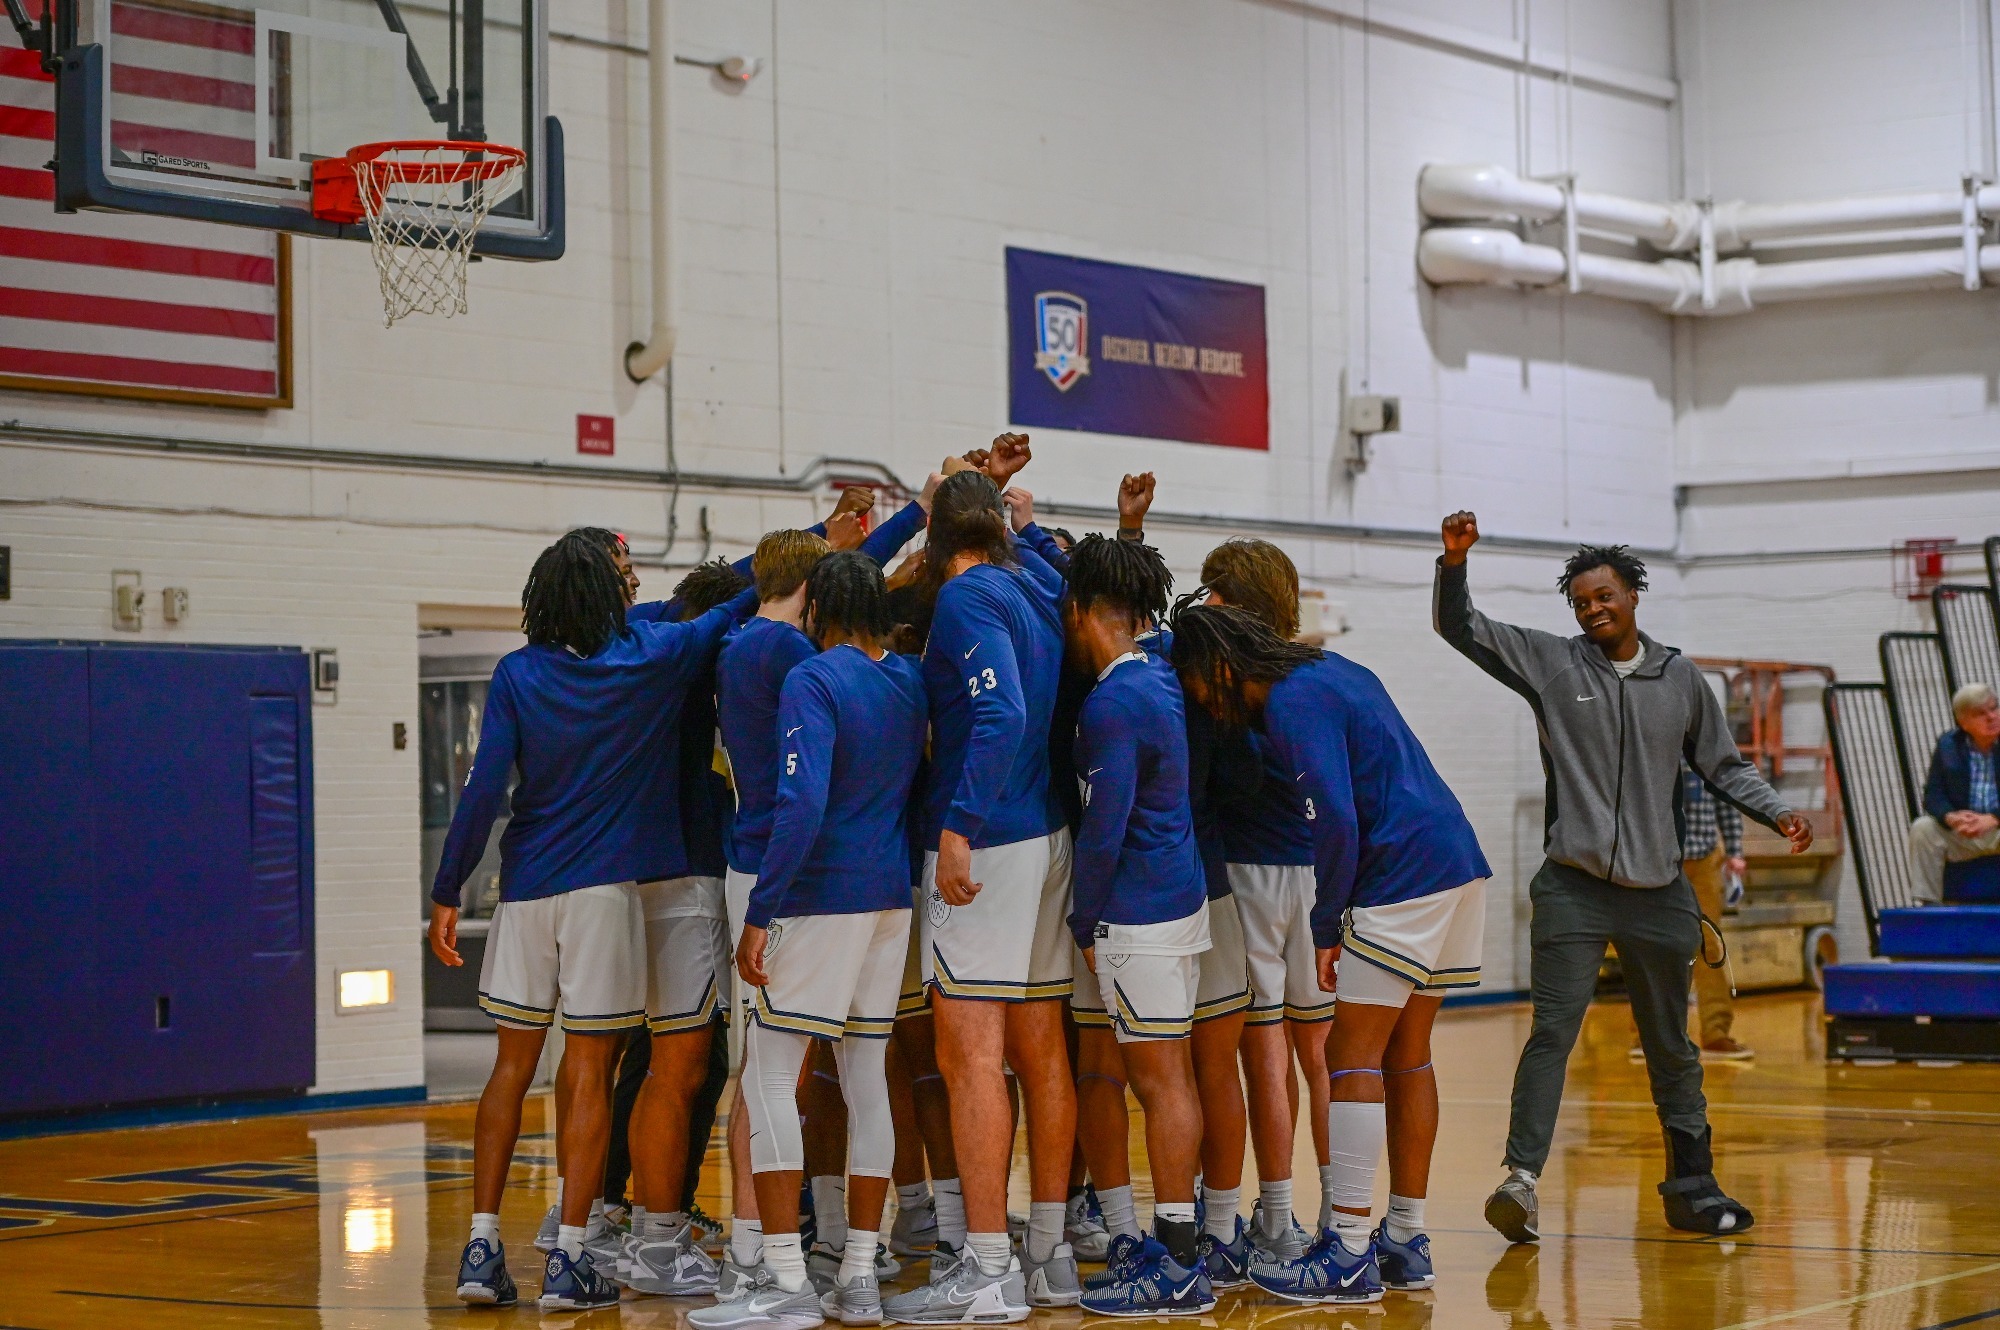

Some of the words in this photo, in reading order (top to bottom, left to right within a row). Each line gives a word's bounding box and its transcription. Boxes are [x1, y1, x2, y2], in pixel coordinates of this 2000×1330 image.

[159, 155, 181, 165] GARED
[1048, 316, 1075, 352] 50
[969, 668, 997, 698] 23
[787, 754, 797, 775] 5
[1306, 798, 1316, 820] 3
